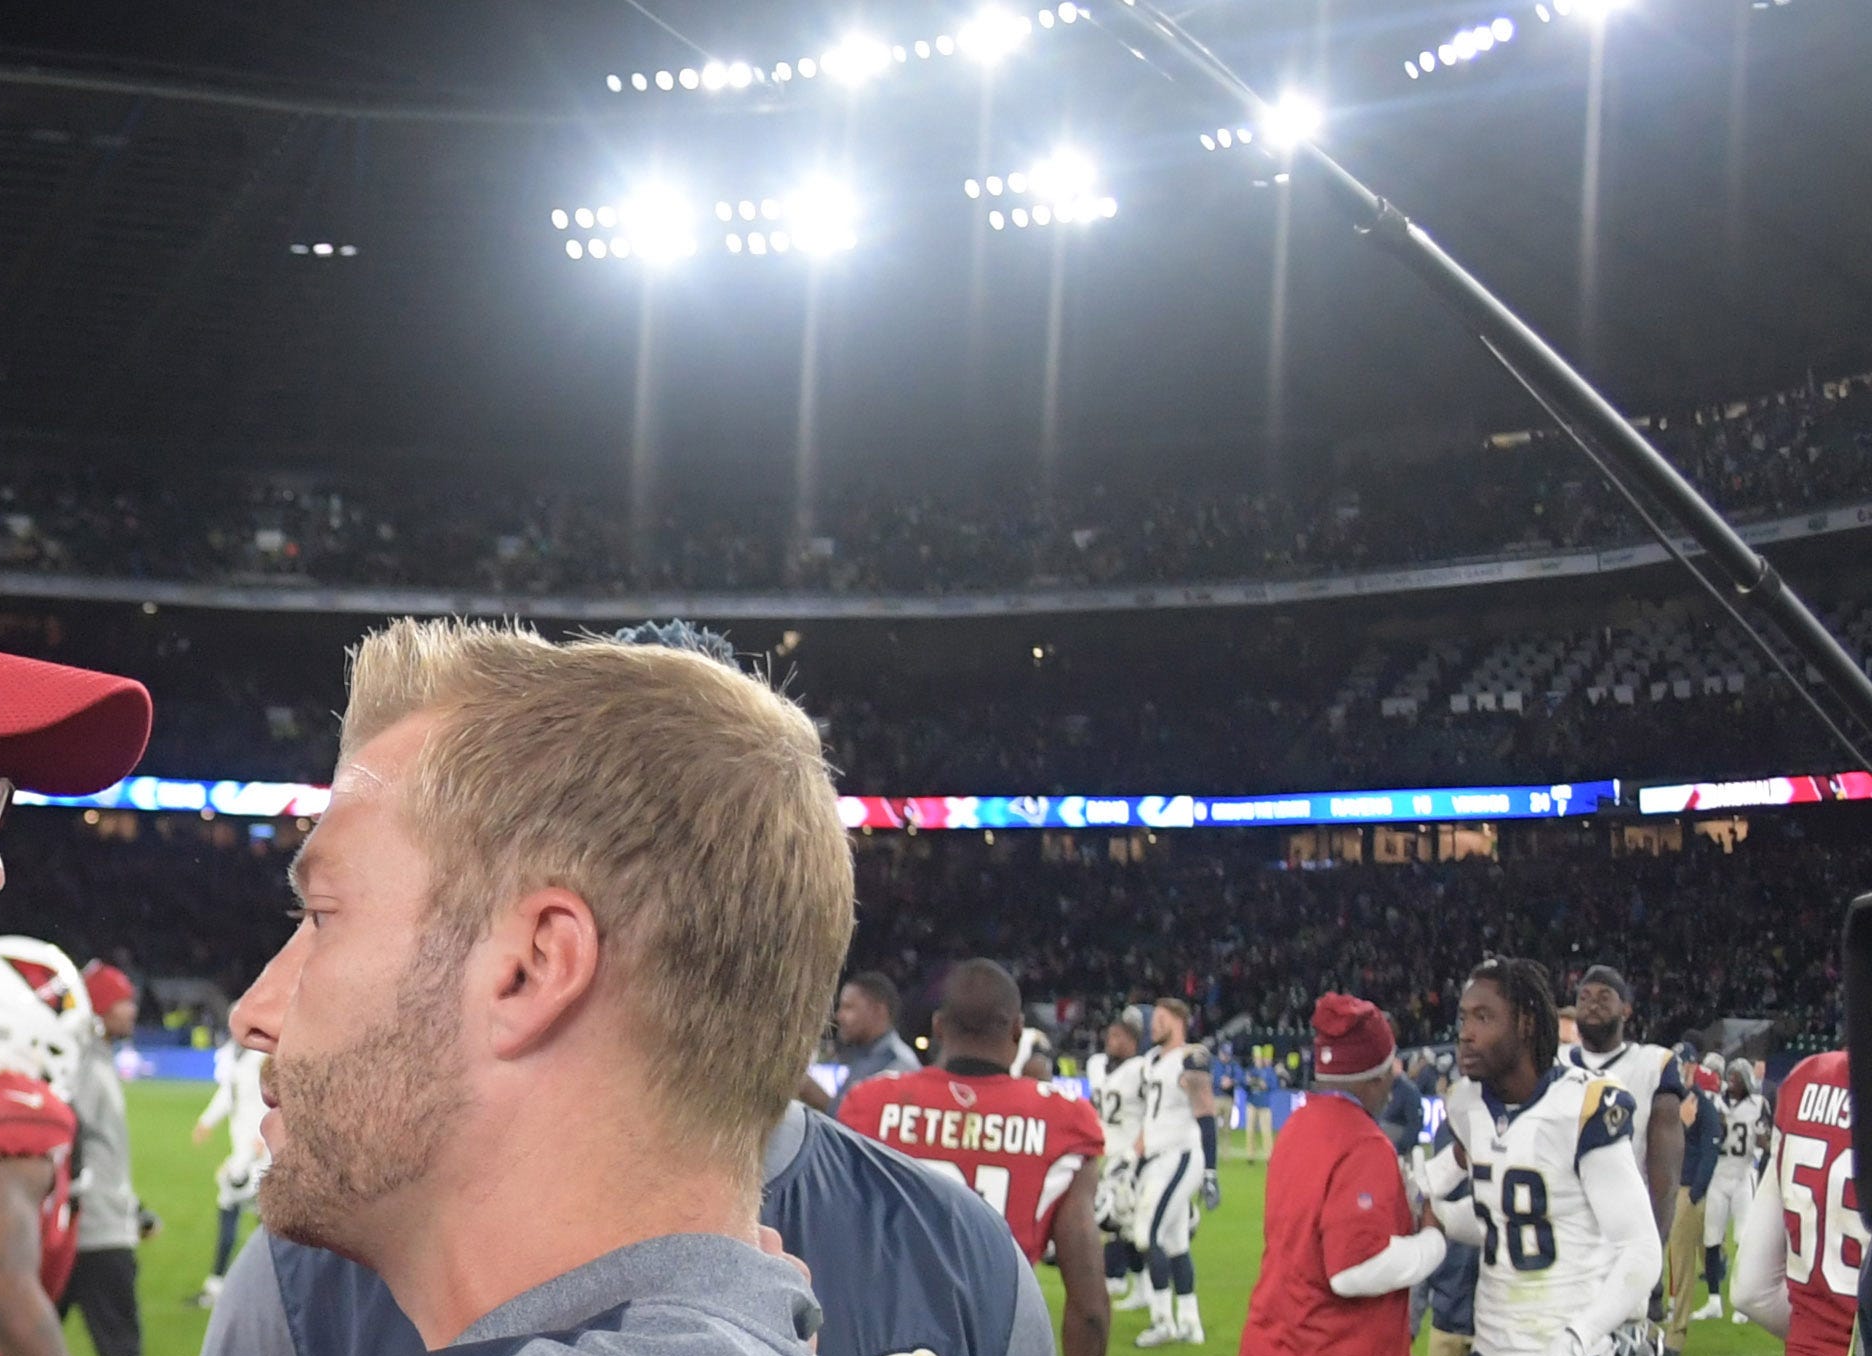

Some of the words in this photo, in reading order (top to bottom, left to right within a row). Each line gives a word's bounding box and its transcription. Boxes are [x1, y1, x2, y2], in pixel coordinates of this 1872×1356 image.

[879, 1103, 1046, 1156] PETERSON
[1472, 1163, 1557, 1271] 58
[1780, 1134, 1870, 1297] 56
